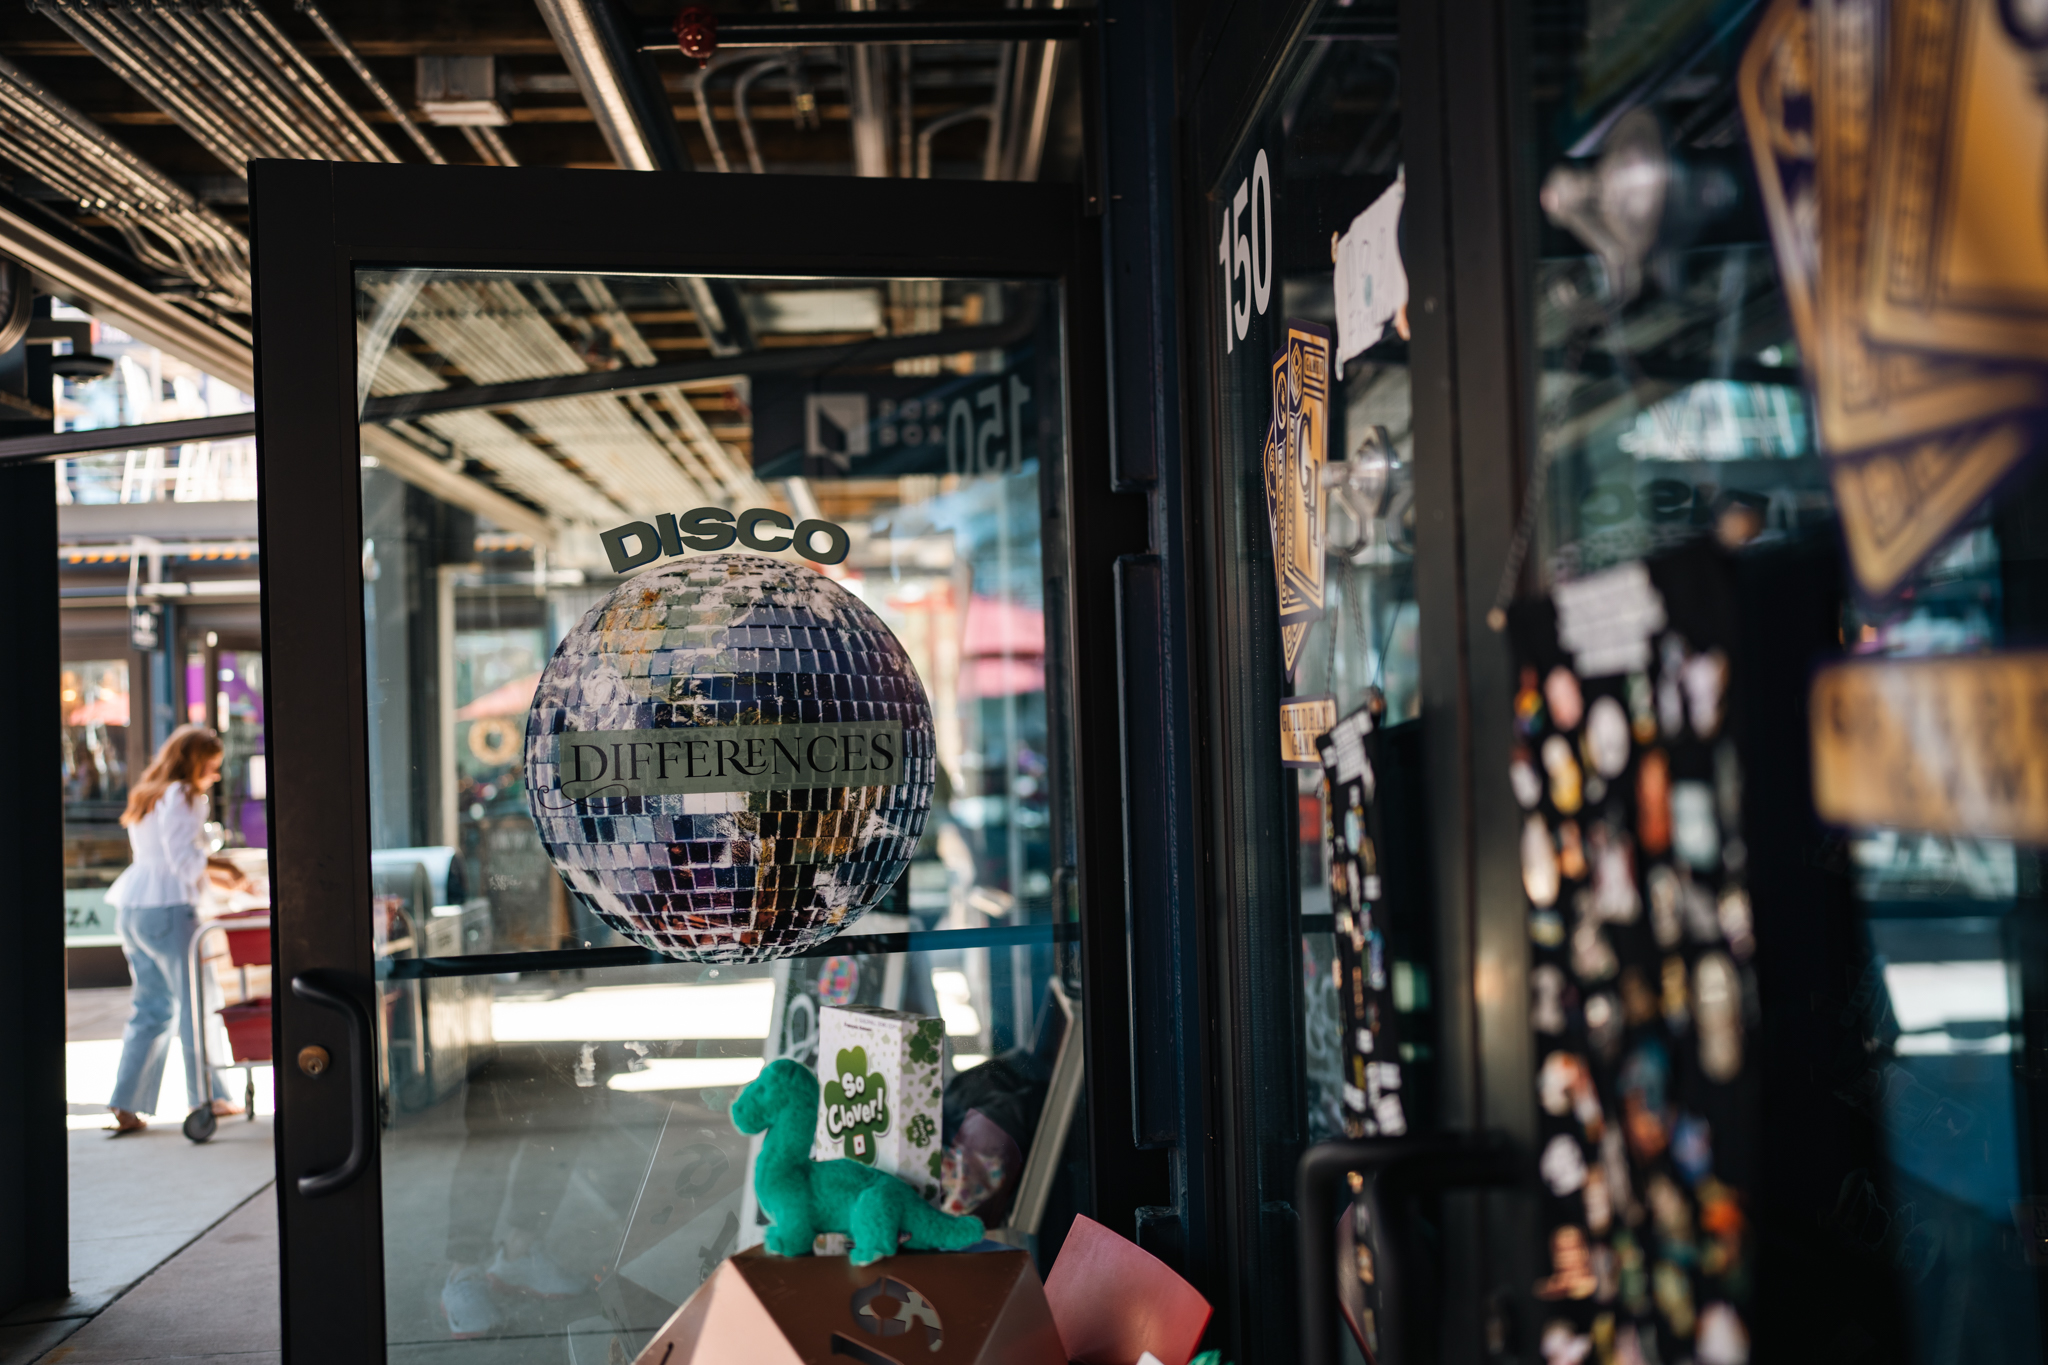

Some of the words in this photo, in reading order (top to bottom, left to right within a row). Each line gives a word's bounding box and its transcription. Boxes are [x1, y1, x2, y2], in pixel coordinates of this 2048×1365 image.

[1219, 148, 1273, 354] 150
[599, 506, 851, 574] DISCO
[548, 733, 896, 796] DIFFERENCES
[828, 1086, 884, 1135] Clover!
[841, 1071, 866, 1099] So
